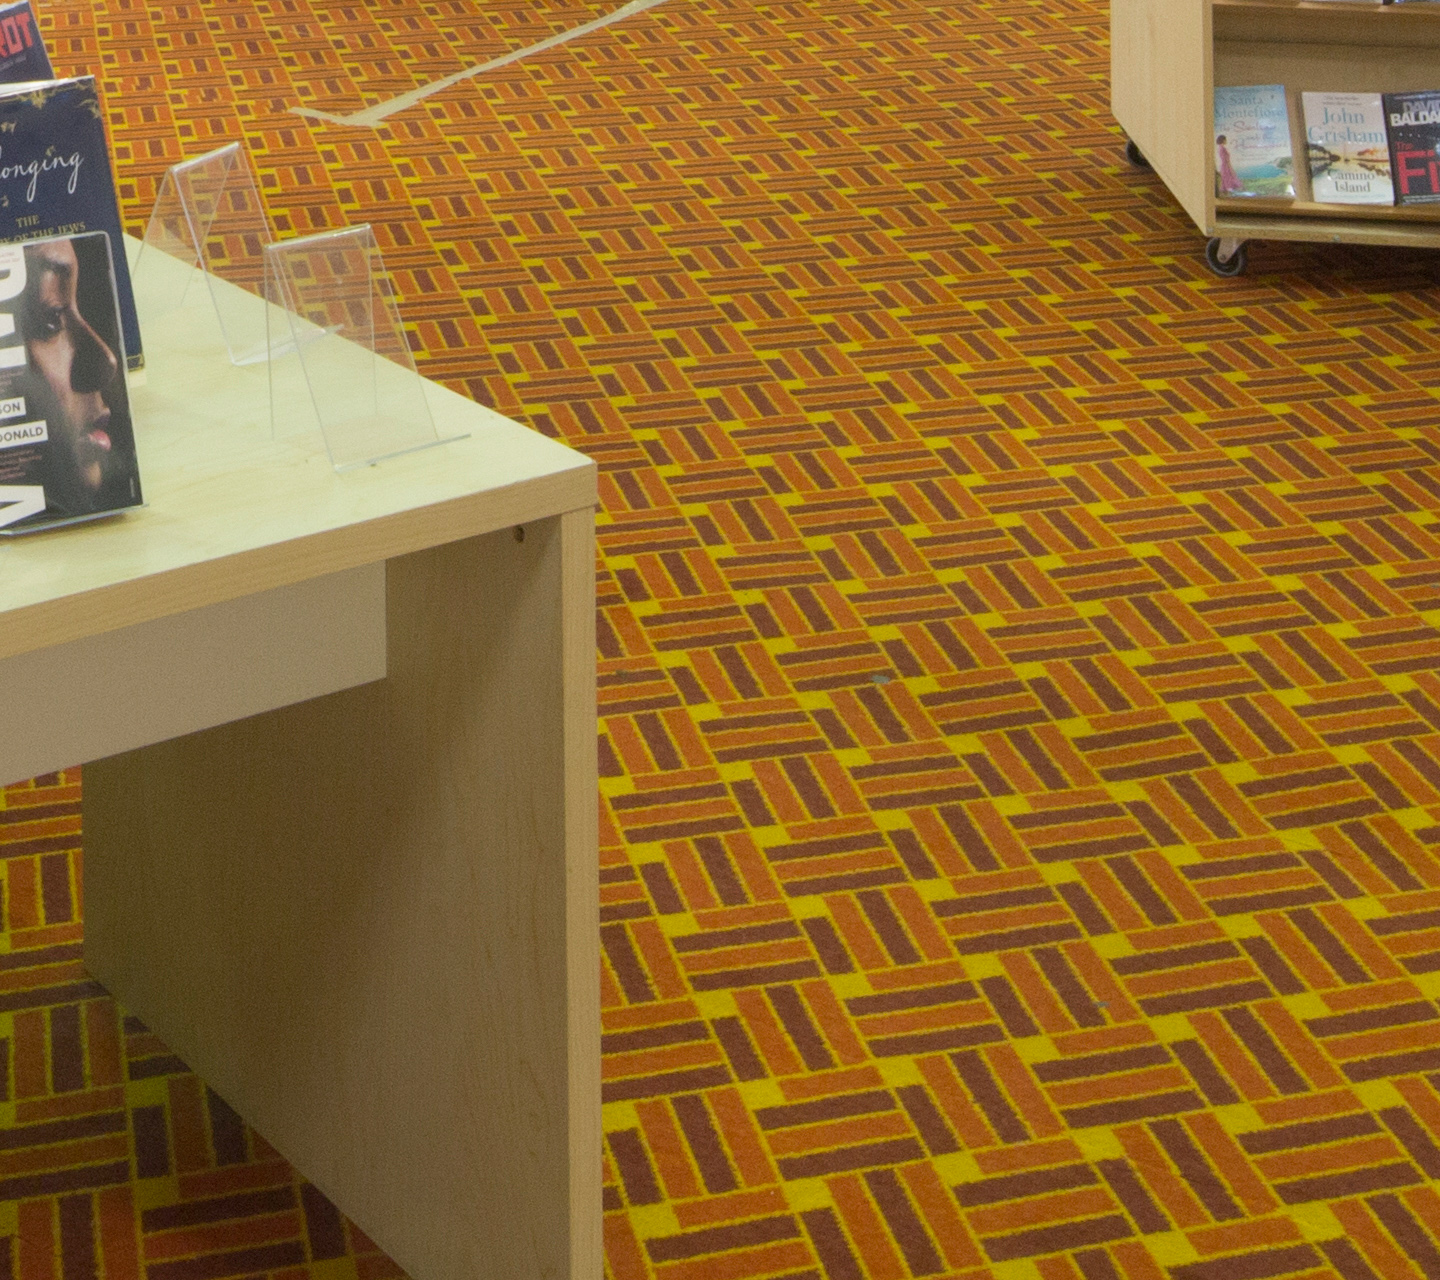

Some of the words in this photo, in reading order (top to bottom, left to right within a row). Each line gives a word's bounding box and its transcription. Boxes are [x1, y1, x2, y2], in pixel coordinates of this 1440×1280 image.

[1323, 107, 1364, 125] John
[1308, 125, 1385, 144] Grisham
[1335, 180, 1370, 193] Island
[16, 214, 40, 228] THE
[57, 221, 86, 233] JEWS
